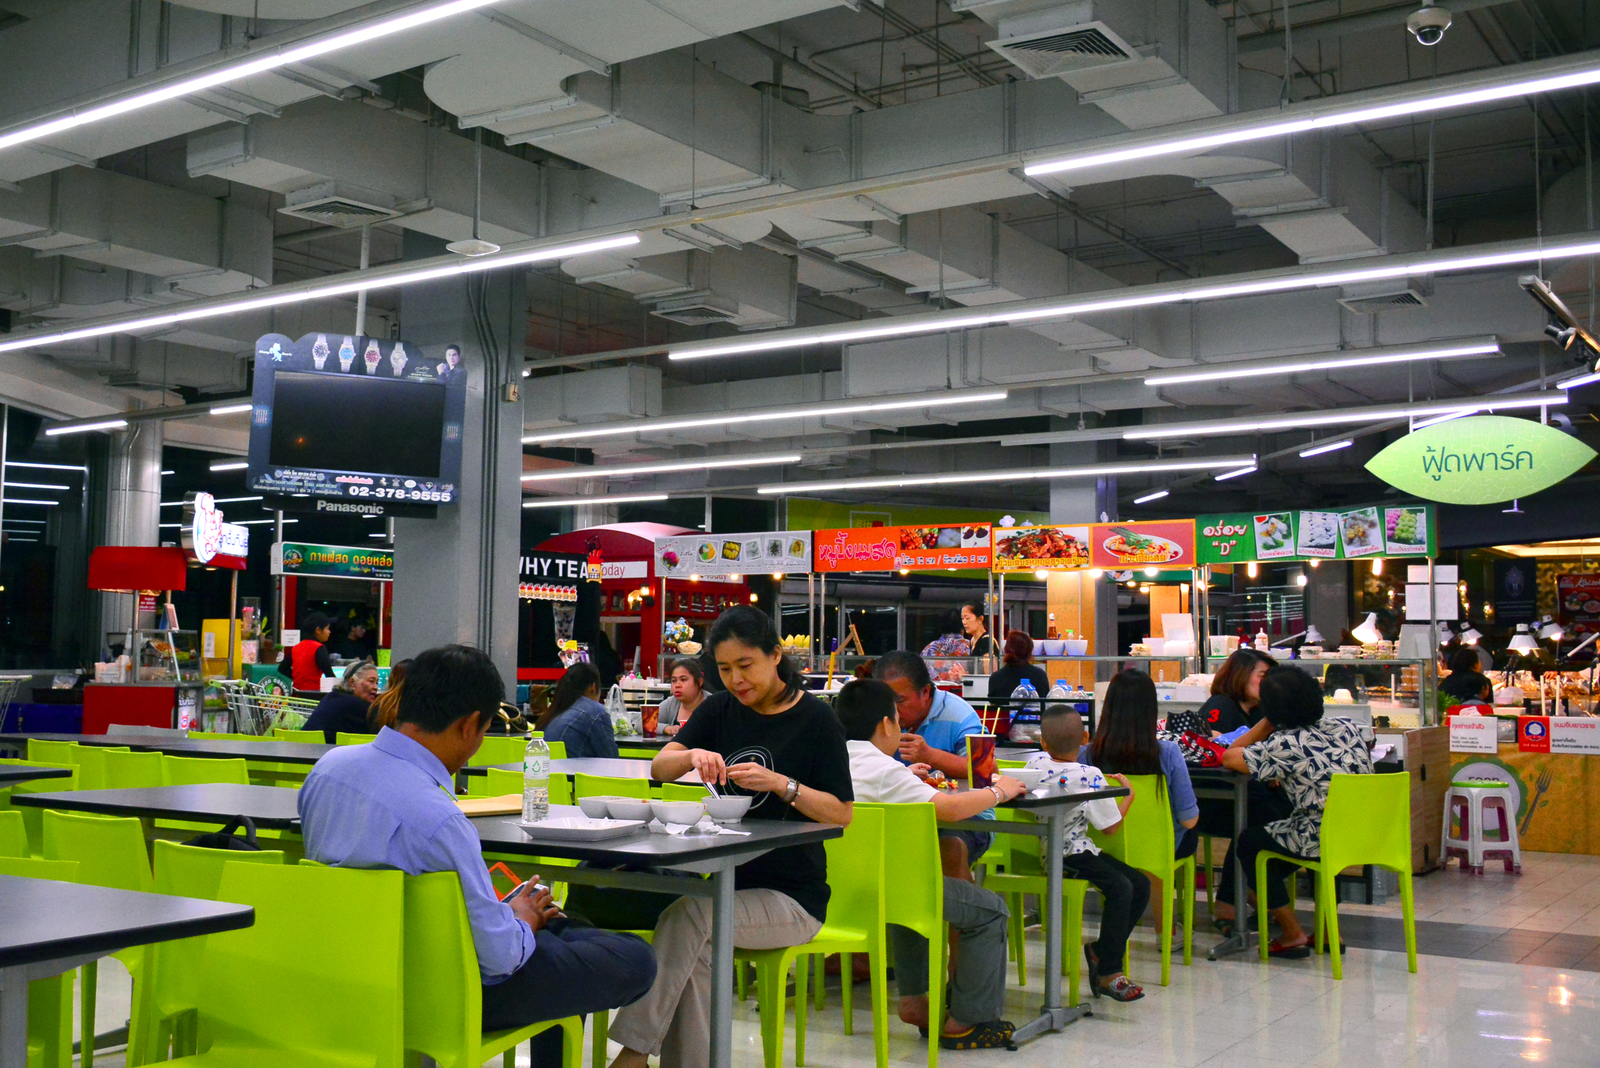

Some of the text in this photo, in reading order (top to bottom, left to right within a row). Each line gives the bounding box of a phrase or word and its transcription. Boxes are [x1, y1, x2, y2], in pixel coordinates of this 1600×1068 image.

[1422, 445, 1533, 482] ฟู้ดพาร์ค
[349, 486, 451, 502] 02-378-9555
[316, 500, 384, 515] Panasonic
[1203, 519, 1248, 537] อร่อย
[819, 531, 897, 568] หมูปิ้งนมสด
[310, 550, 349, 564] กาแฟสด
[353, 554, 393, 567] ดอยหล่อ
[519, 556, 589, 579] HY TEA
[601, 563, 625, 578] oday
[1207, 708, 1220, 723] 3
